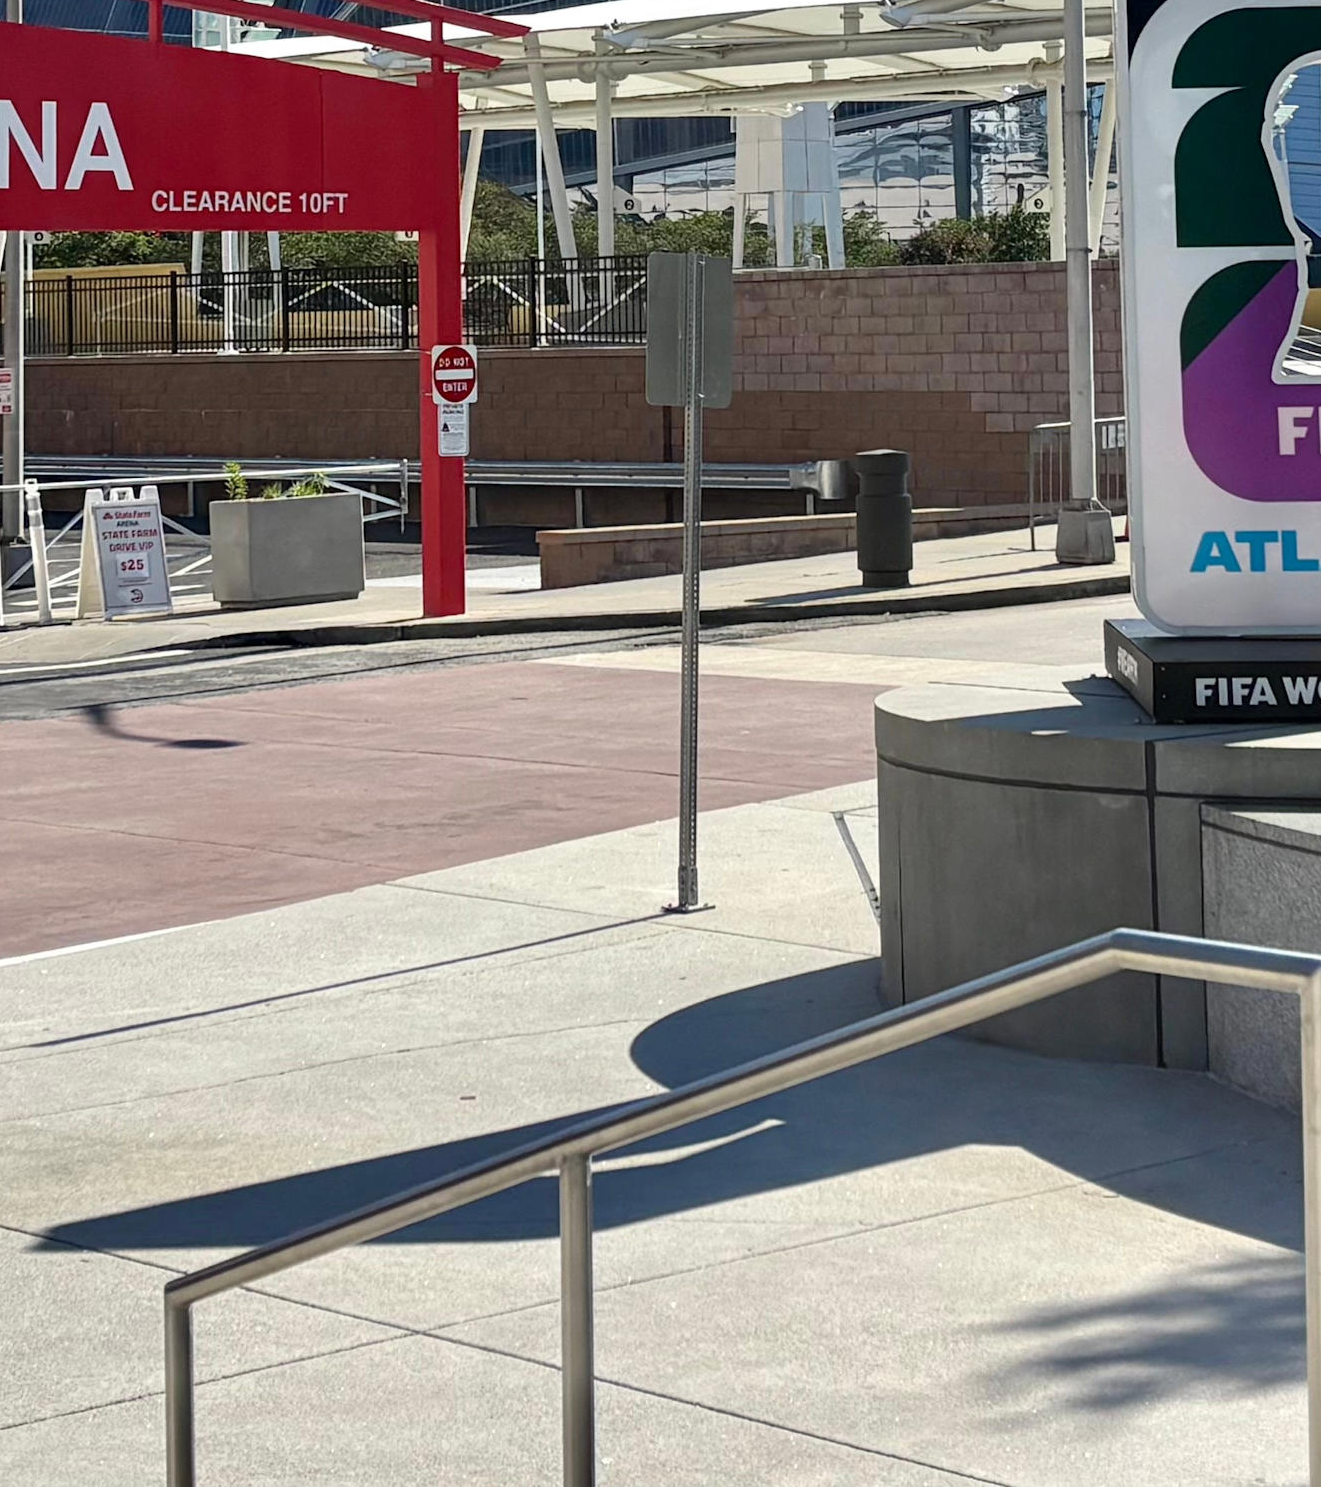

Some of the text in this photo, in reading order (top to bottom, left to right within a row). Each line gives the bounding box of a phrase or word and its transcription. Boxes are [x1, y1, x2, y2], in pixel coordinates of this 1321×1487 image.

[152, 190, 349, 214] CLEARANCE 10FT
[439, 357, 470, 367] DO NOT
[442, 382, 468, 392] ENTER
[102, 529, 158, 540] STATE FARM
[109, 541, 154, 552] DRIVE VIP
[120, 559, 144, 571] $25
[1195, 677, 1277, 706] FIFA
